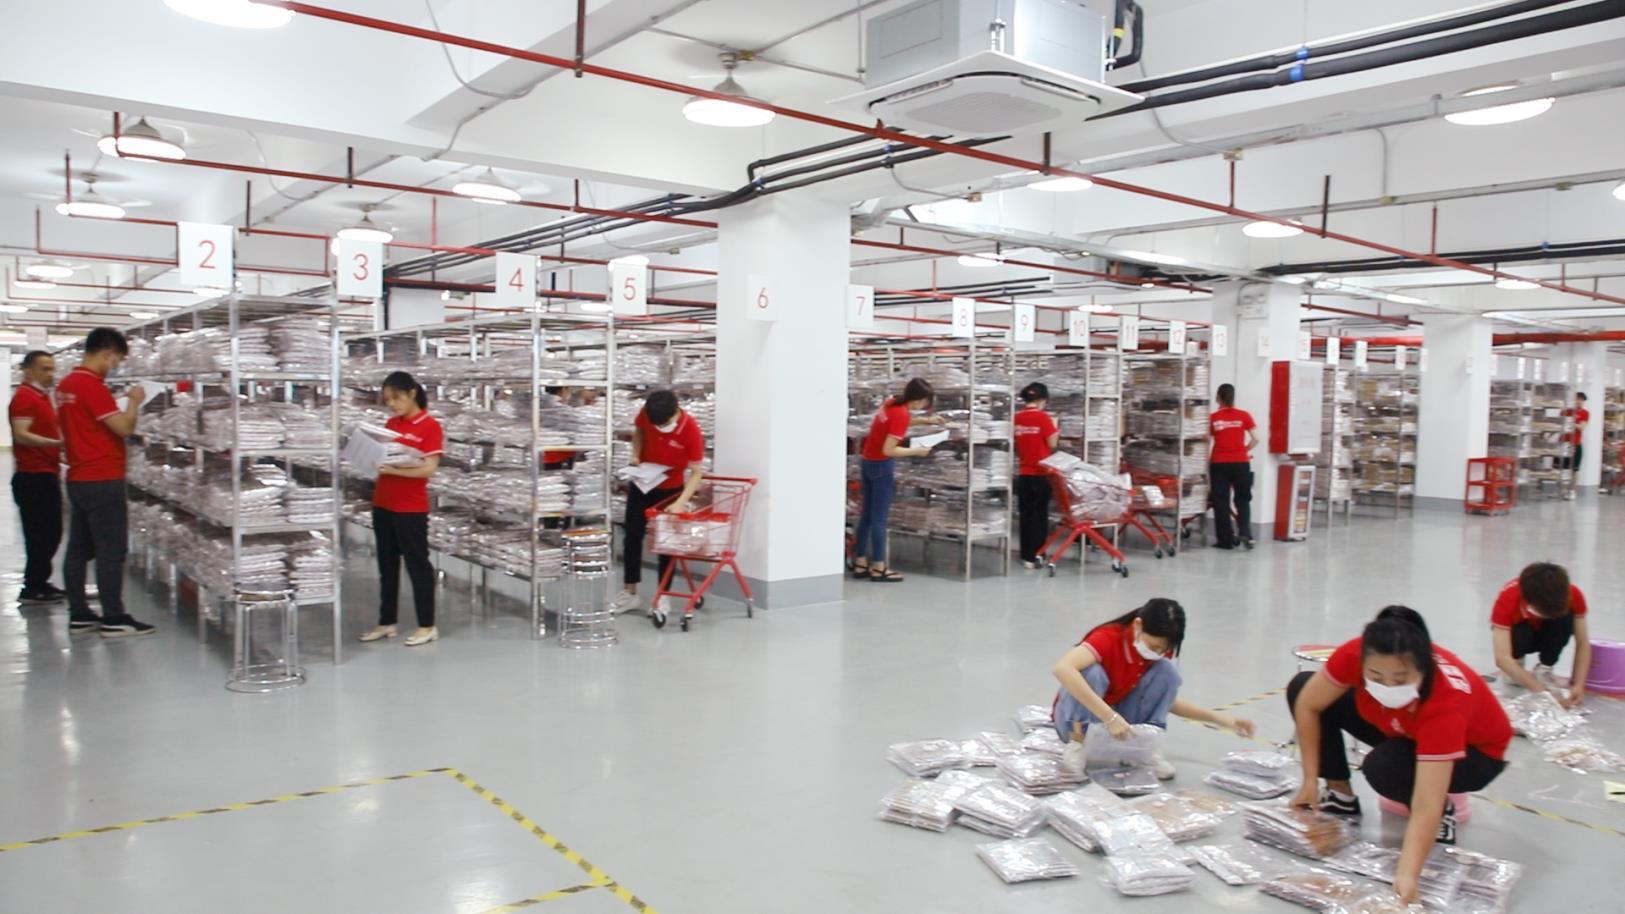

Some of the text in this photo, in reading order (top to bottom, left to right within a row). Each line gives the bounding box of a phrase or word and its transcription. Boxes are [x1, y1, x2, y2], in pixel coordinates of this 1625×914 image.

[198, 239, 216, 270] 2
[353, 252, 369, 283] 3
[509, 270, 525, 290] 4
[623, 277, 636, 302] 5
[757, 288, 769, 309] 6
[856, 296, 866, 316] 7
[959, 308, 969, 327] 8
[1020, 314, 1029, 332] 9
[1073, 319, 1086, 337] 10
[1125, 325, 1136, 342] 11
[1172, 328, 1183, 345] 12
